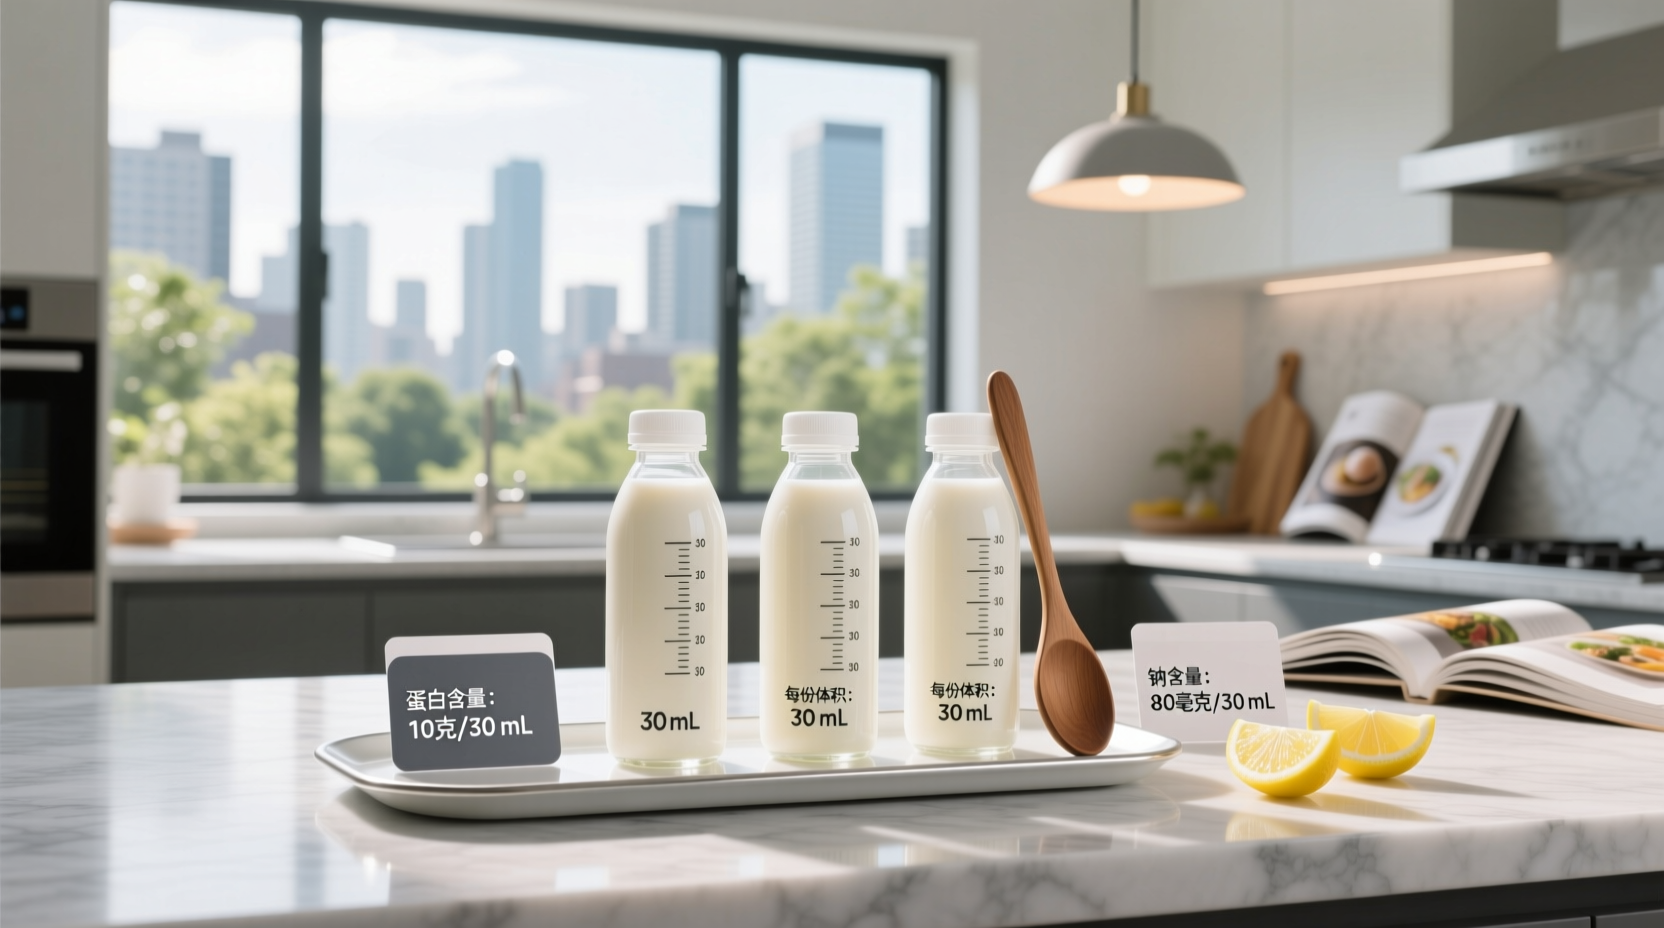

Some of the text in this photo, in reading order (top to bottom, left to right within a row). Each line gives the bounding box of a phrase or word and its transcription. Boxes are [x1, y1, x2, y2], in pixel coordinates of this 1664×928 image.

[406, 687, 496, 712] 蛋白含量：
[1248, 691, 1276, 710] mL
[640, 710, 701, 731] 30 mL
[790, 707, 848, 727] 30 mL
[938, 703, 993, 722] 30 mL
[408, 714, 534, 742] 10克/30 mL
